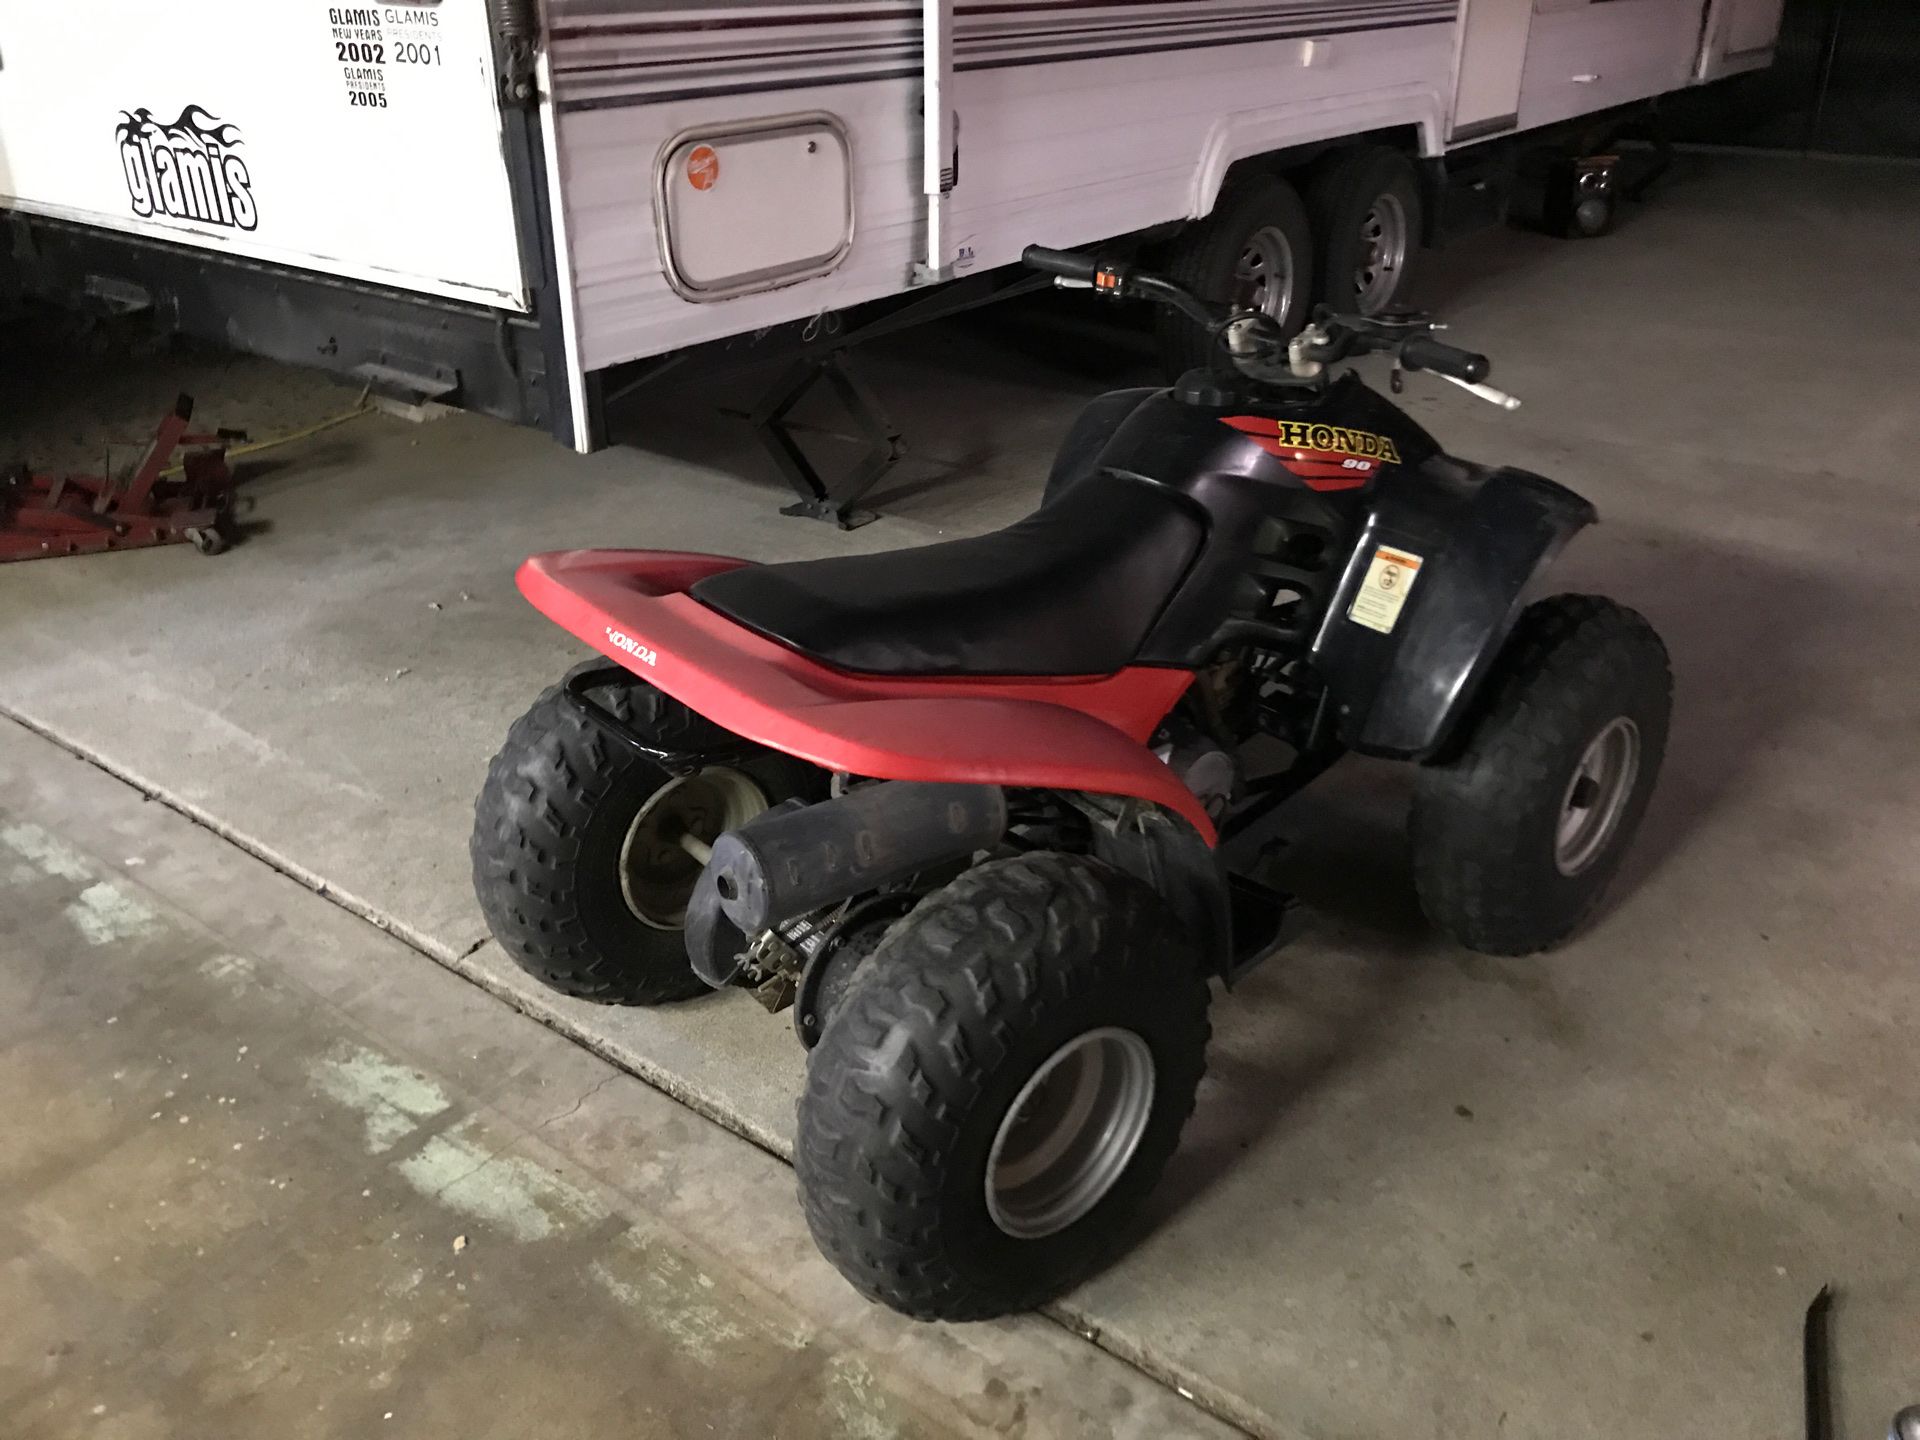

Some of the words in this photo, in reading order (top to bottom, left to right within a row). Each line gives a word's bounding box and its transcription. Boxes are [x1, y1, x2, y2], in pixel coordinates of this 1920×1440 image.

[329, 8, 381, 27] GLAMIS
[385, 9, 439, 27] GLAMIS
[332, 28, 351, 40] NEW
[354, 29, 383, 41] YEARS
[335, 42, 386, 64] 2002
[394, 42, 441, 66] 2001
[344, 67, 383, 82] GLAMIS
[349, 91, 387, 108] 2005
[1278, 420, 1402, 464] HONDA
[1341, 459, 1372, 471] 90
